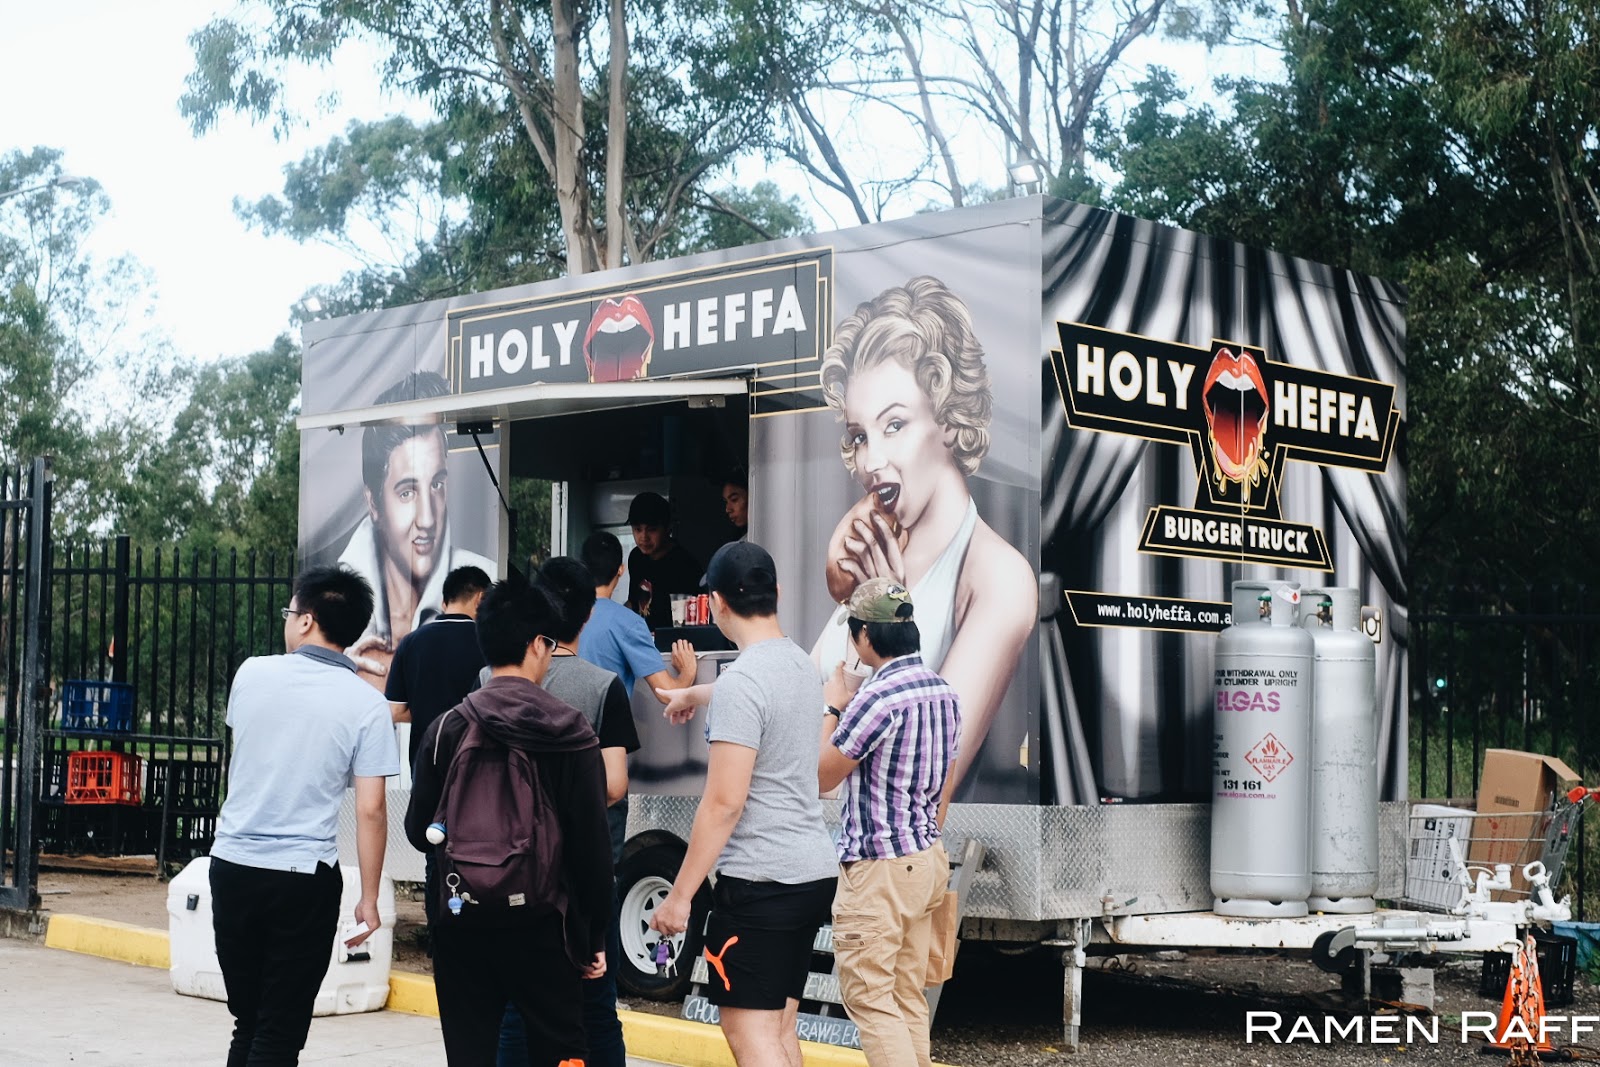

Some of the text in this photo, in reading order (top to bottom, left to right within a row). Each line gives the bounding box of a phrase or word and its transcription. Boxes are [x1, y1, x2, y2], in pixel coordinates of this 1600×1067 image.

[469, 284, 807, 379] HOLY HEFFA
[1076, 343, 1380, 442] HOLY HEFFA
[1164, 515, 1309, 553] BURGER TRUCK
[1097, 602, 1232, 625] www.holyheffa.com.a
[1224, 678, 1259, 686] CYLINDER
[1264, 679, 1298, 687] UPRIGHT
[1227, 670, 1276, 678] WITHDRAWAL
[1278, 670, 1298, 679] ONLY
[1217, 690, 1280, 712] ELGAS
[1223, 779, 1262, 790] 131 161
[685, 999, 720, 1023] CHOC
[795, 1018, 860, 1047] TRAWBER
